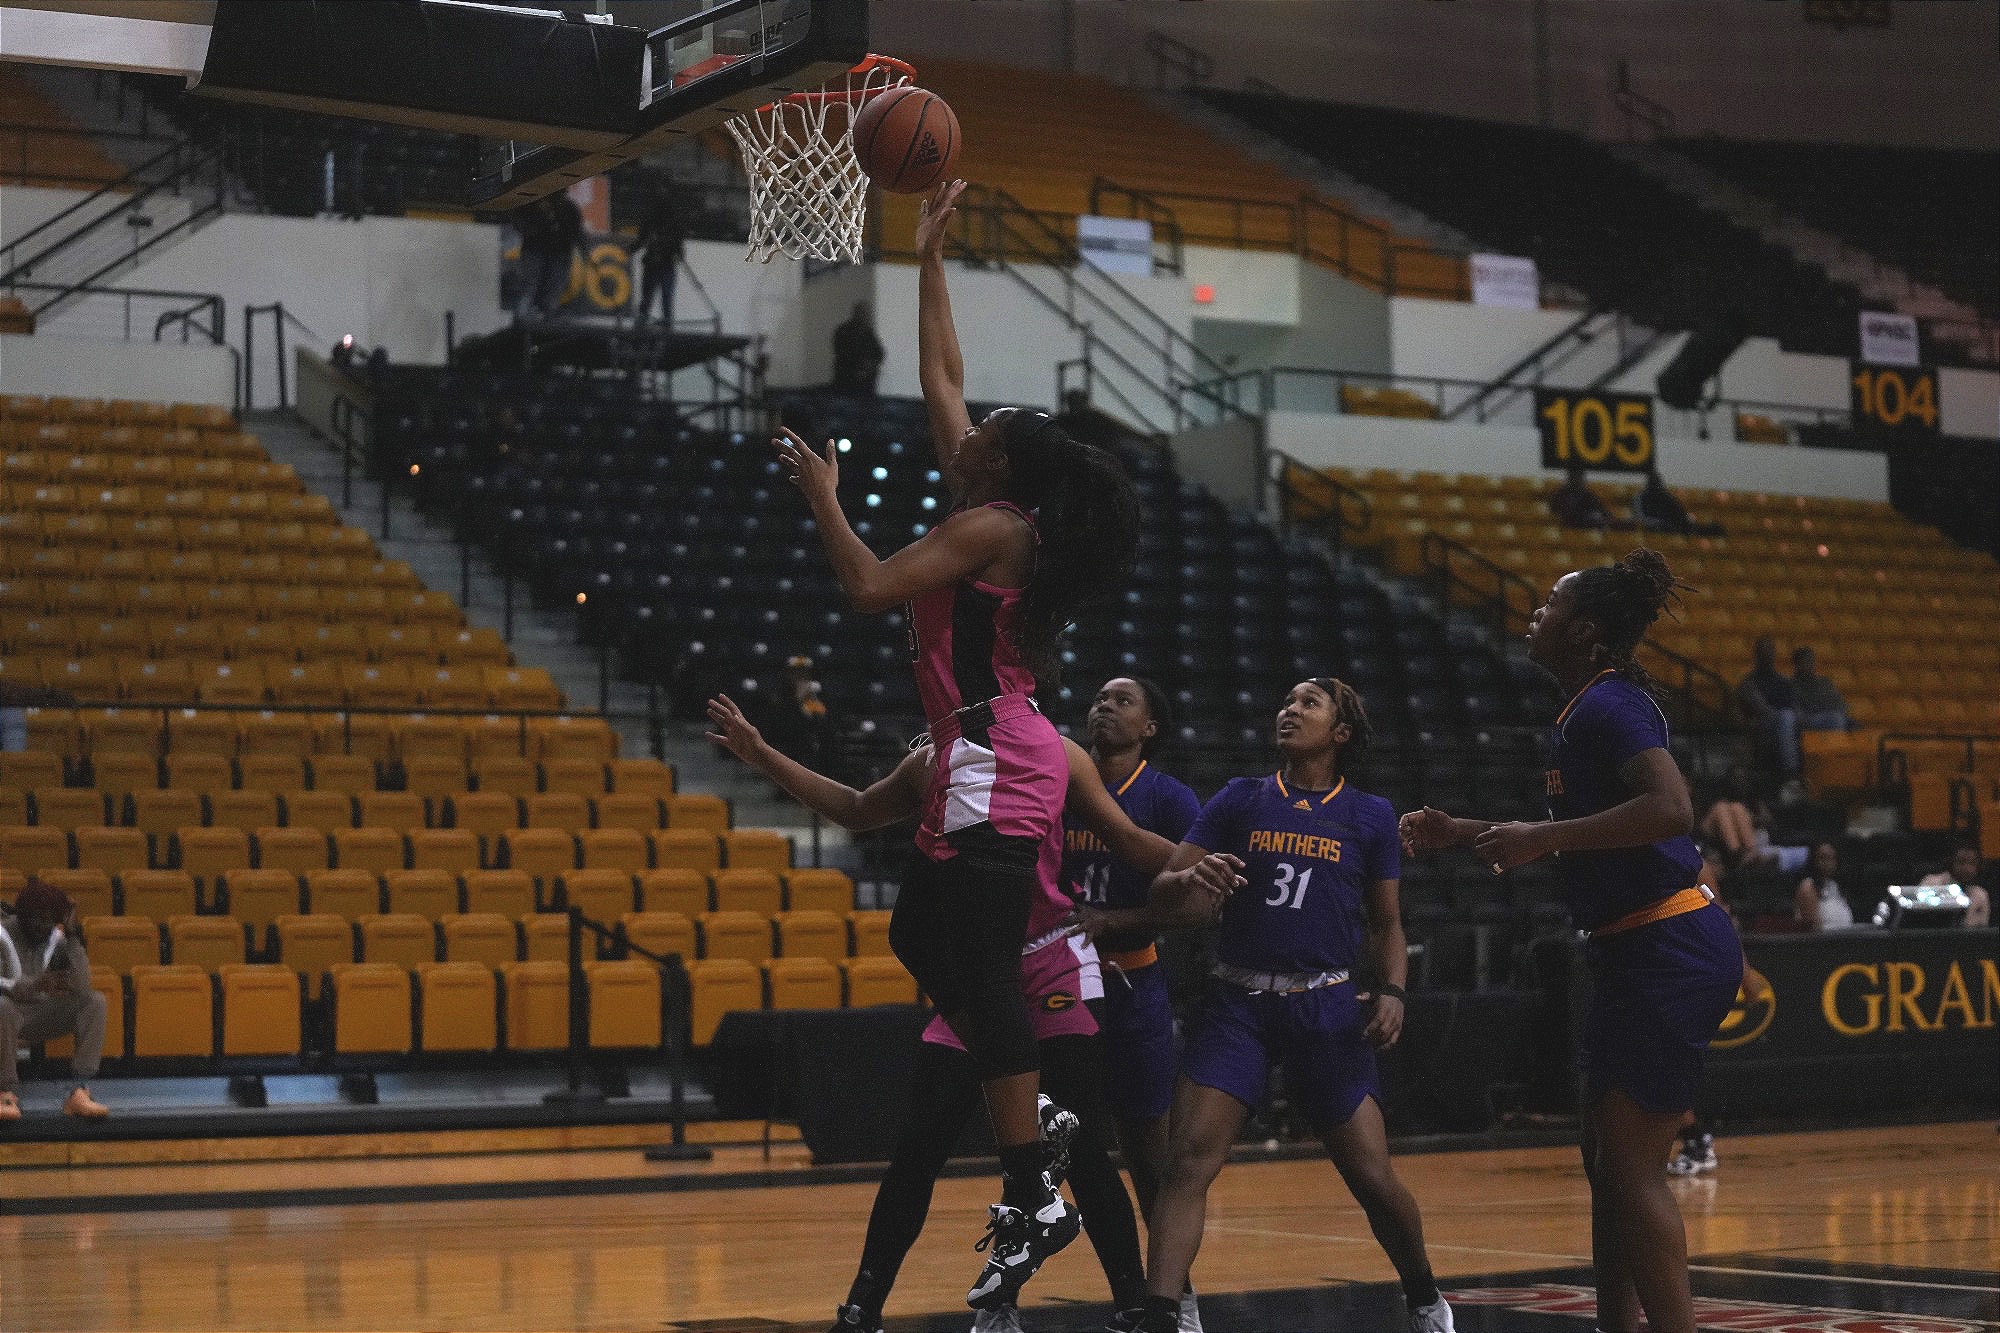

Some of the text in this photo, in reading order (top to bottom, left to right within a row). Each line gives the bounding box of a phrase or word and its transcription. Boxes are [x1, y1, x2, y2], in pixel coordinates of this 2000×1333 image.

[1855, 370, 1937, 427] 104
[1543, 397, 1652, 466] 105
[1248, 830, 1342, 863] PANTHERS
[1083, 862, 1111, 902] 11
[1265, 862, 1313, 909] 31
